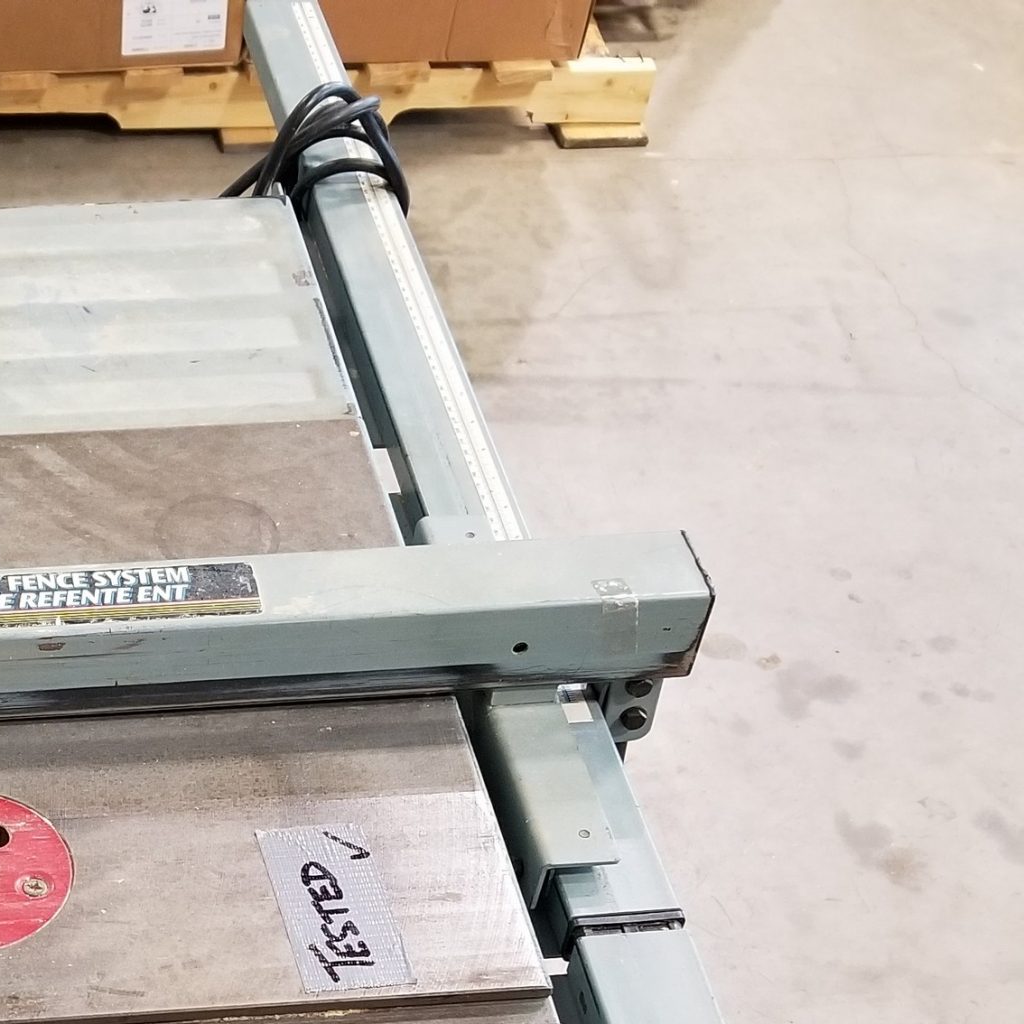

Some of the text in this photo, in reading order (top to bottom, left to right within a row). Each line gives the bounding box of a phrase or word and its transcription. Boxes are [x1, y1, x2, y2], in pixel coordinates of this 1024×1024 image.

[7, 571, 90, 592] FENCE
[90, 566, 192, 588] SYSTEM
[18, 586, 132, 609] REFENTE
[136, 583, 191, 604] ENT
[300, 861, 375, 983] TESTED
